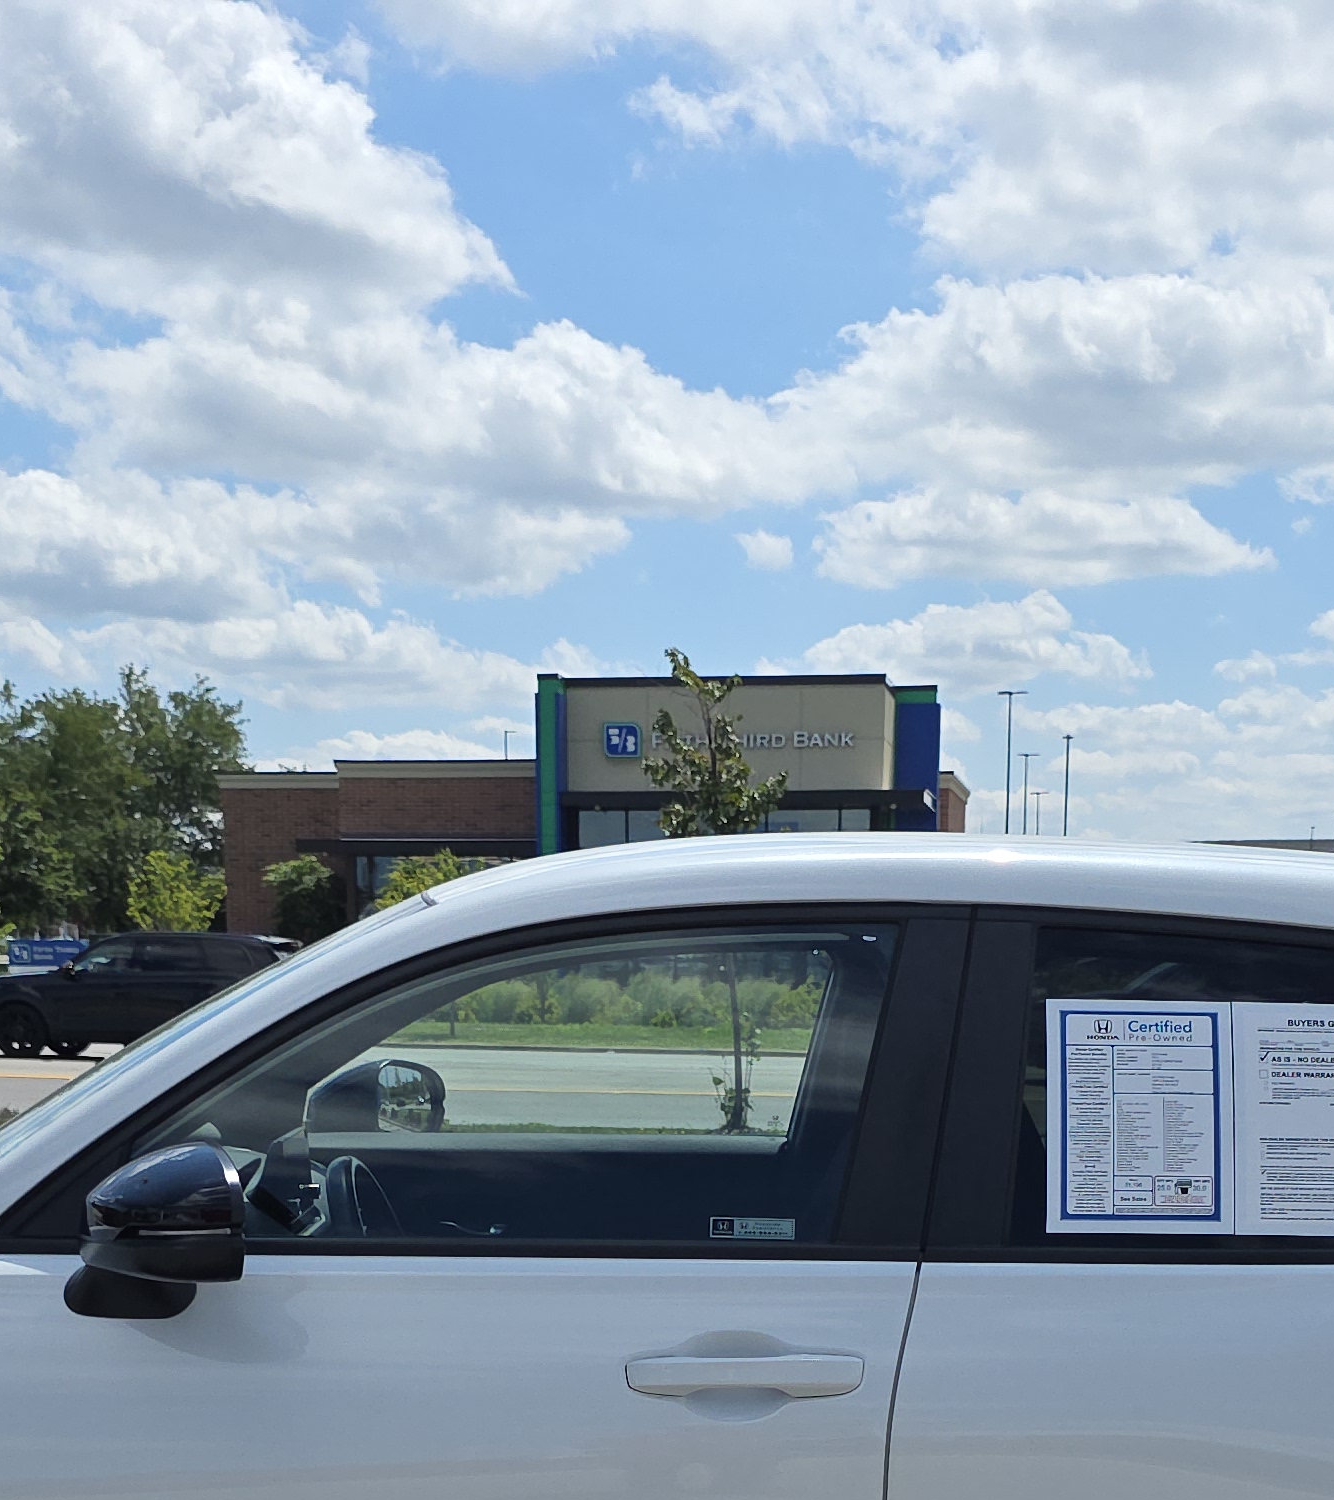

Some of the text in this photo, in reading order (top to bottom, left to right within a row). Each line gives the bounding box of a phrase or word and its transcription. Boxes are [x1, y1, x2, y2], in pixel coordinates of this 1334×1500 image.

[793, 731, 854, 748] BANK
[1127, 1019, 1193, 1033] Certified
[1287, 1019, 1326, 1028] BUYERS
[1128, 1033, 1193, 1042] Pre-Owned
[1297, 1056, 1309, 1064] NO
[1271, 1071, 1302, 1079] DEALER
